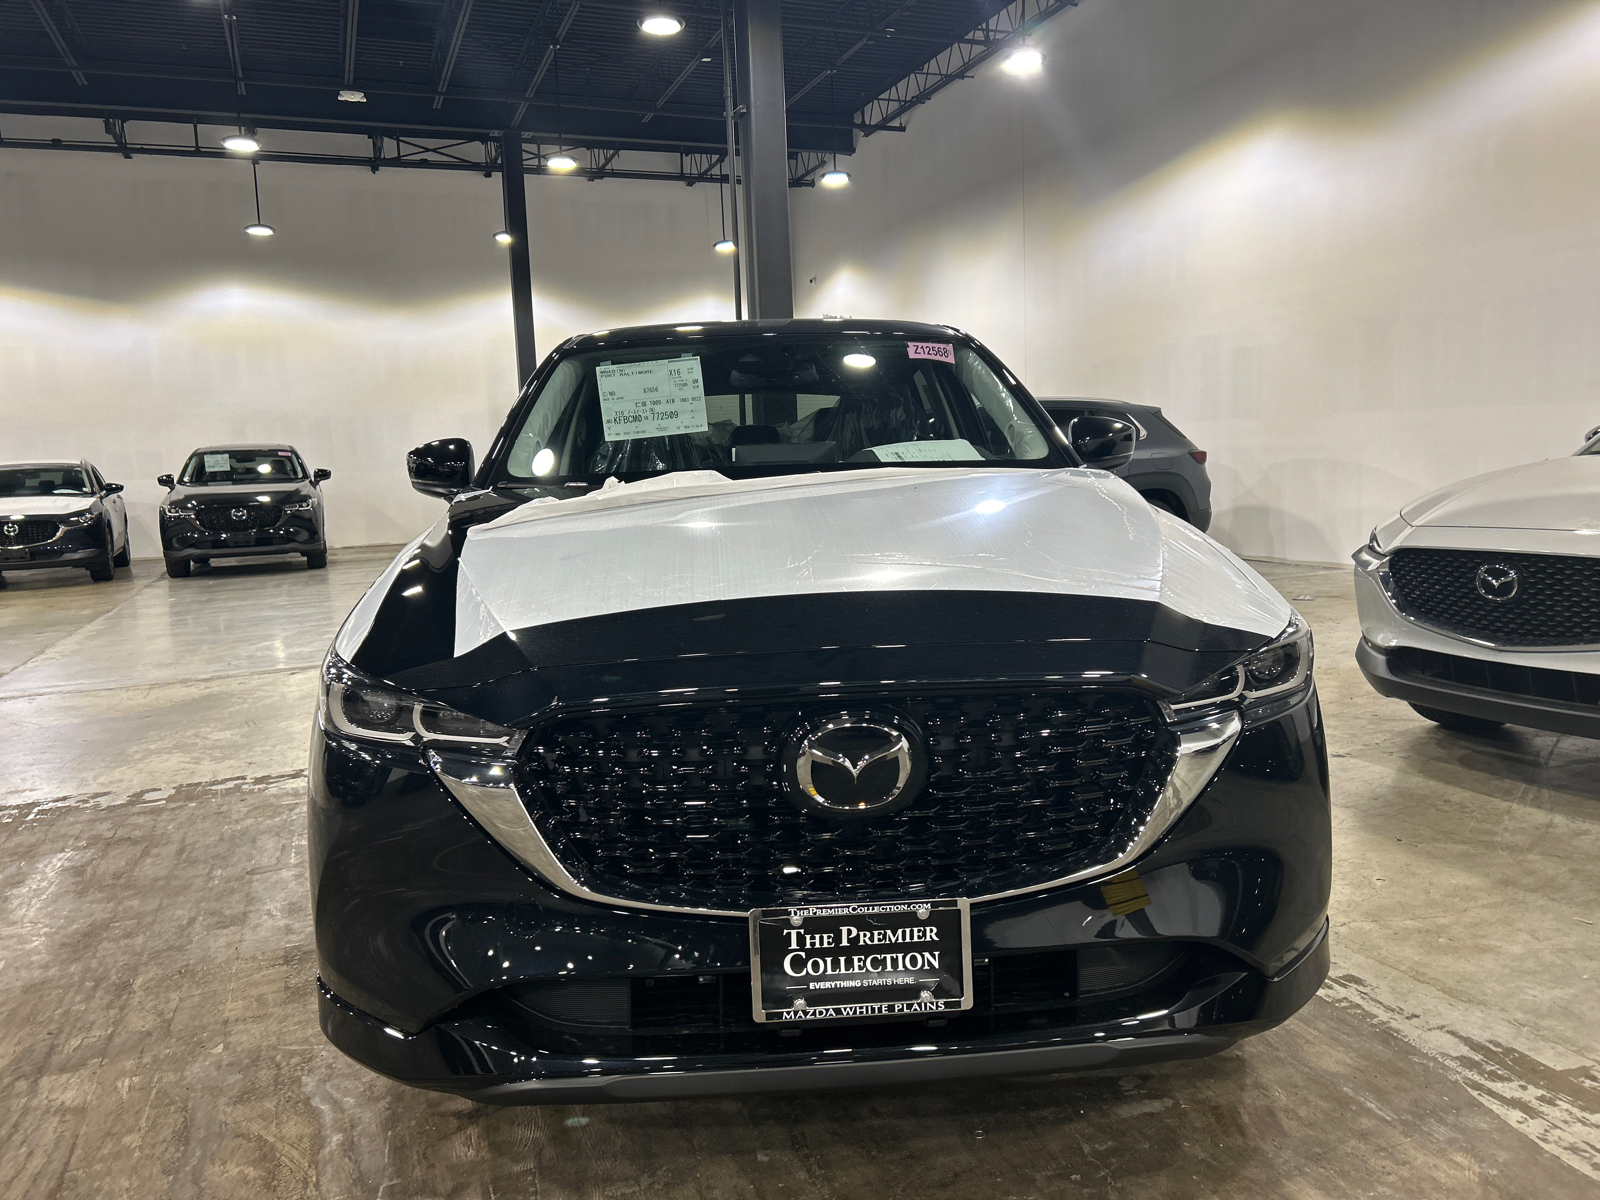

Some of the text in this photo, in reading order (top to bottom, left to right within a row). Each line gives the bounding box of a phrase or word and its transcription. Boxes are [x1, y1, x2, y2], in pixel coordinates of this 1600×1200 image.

[912, 344, 949, 358] Z12568
[619, 369, 653, 377] BALTIMORE
[668, 368, 681, 377] X16
[642, 386, 659, 394] 87656
[651, 411, 679, 421] 772509
[783, 925, 940, 950] THE PREMIER
[783, 951, 940, 977] COLLECTION
[809, 976, 917, 990] EVERYTHING STARTS HERE.
[782, 1000, 945, 1020] MAZDA WHITE PLAINS
